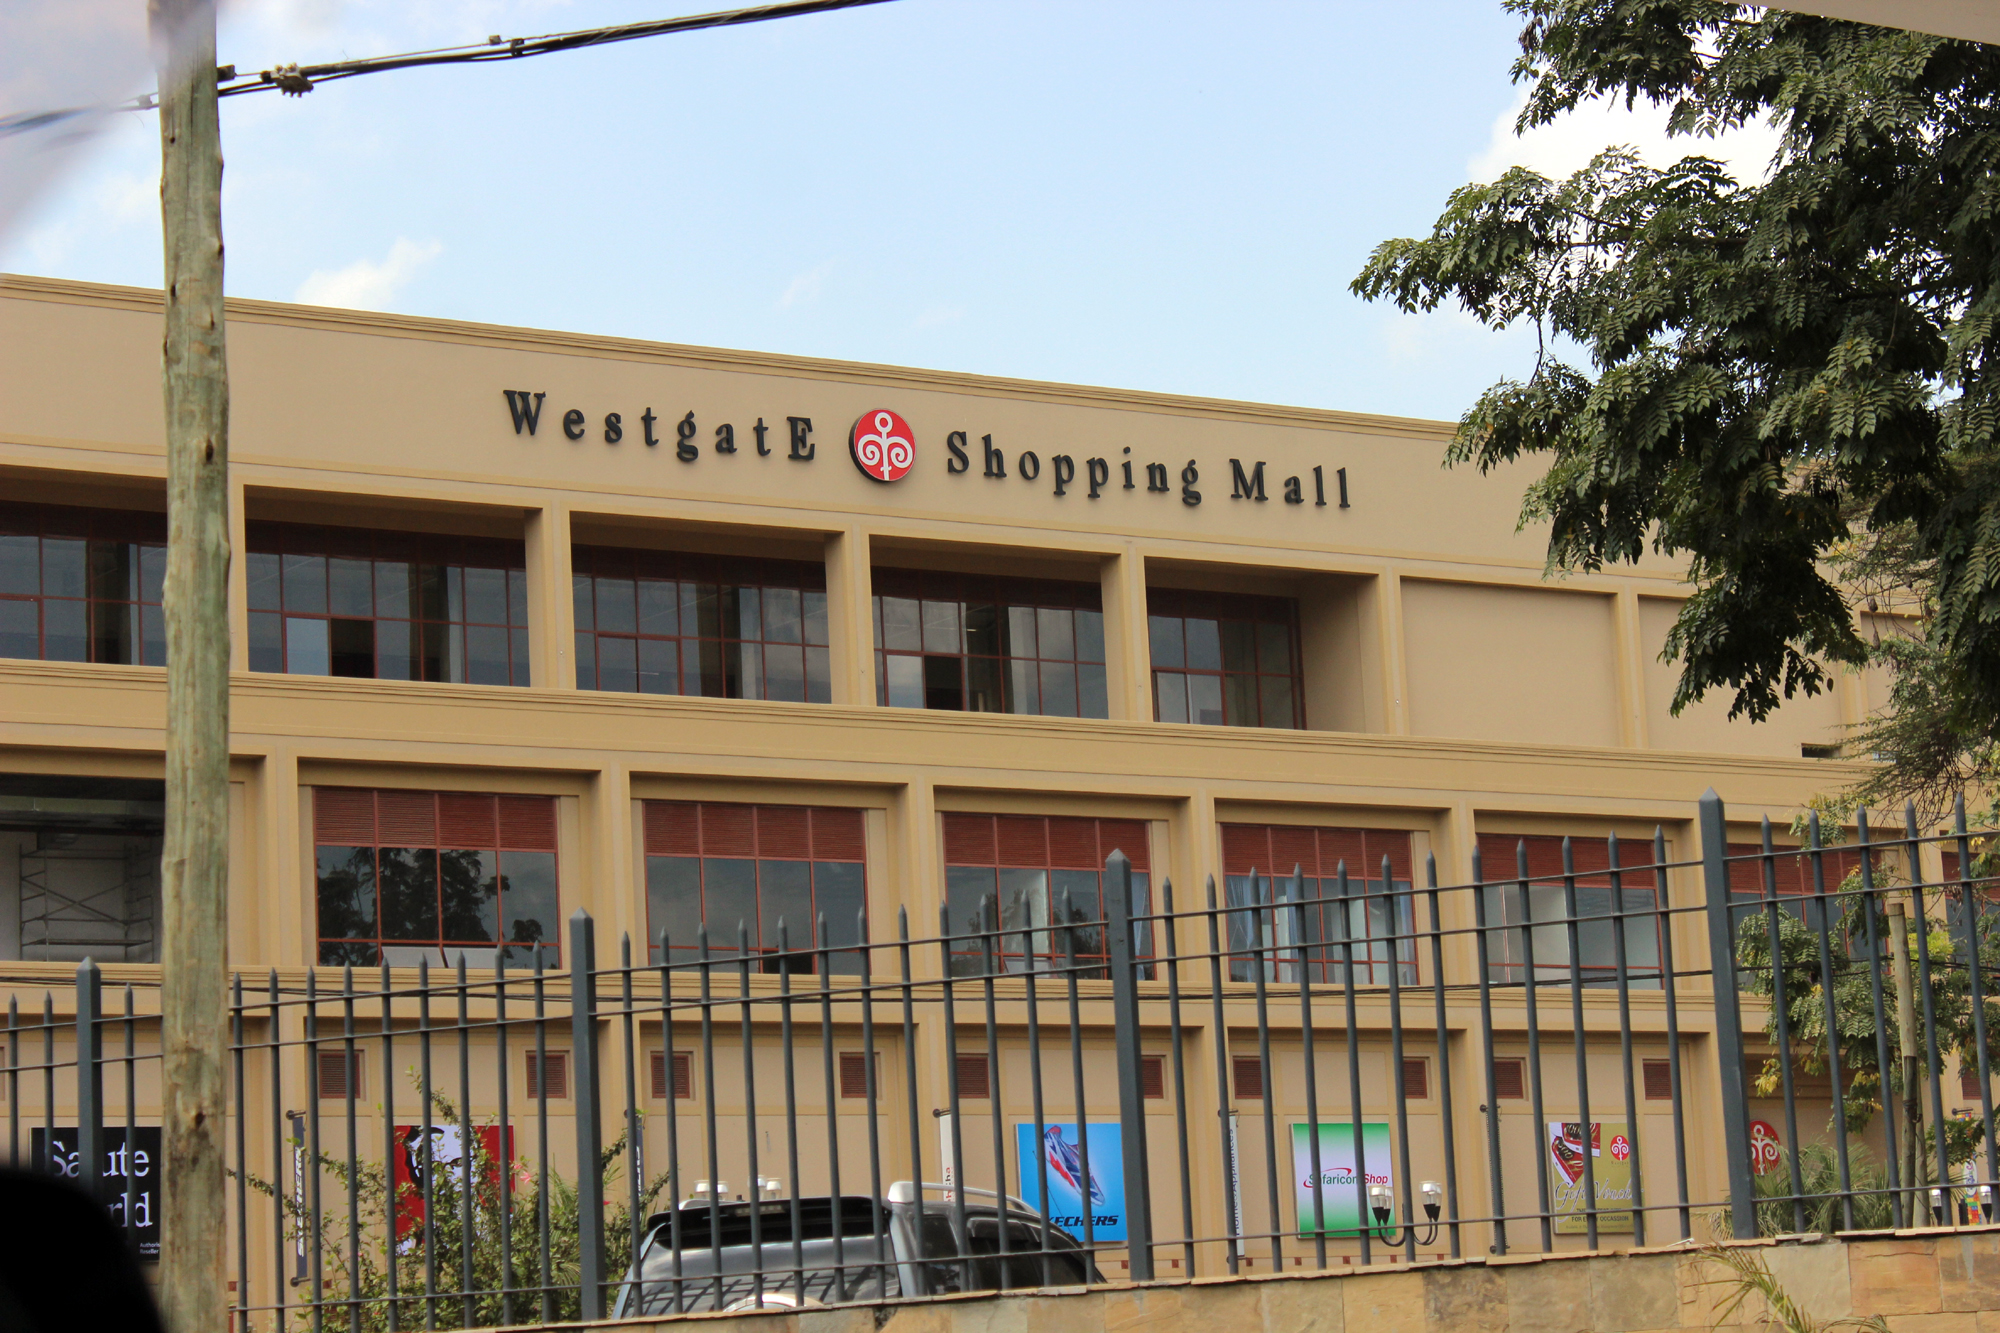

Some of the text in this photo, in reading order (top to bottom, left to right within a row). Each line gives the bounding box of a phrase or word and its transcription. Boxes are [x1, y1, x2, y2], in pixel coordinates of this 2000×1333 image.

[503, 389, 1351, 508] WestgatE Shopping Mall
[1364, 1173, 1389, 1185] Shop
